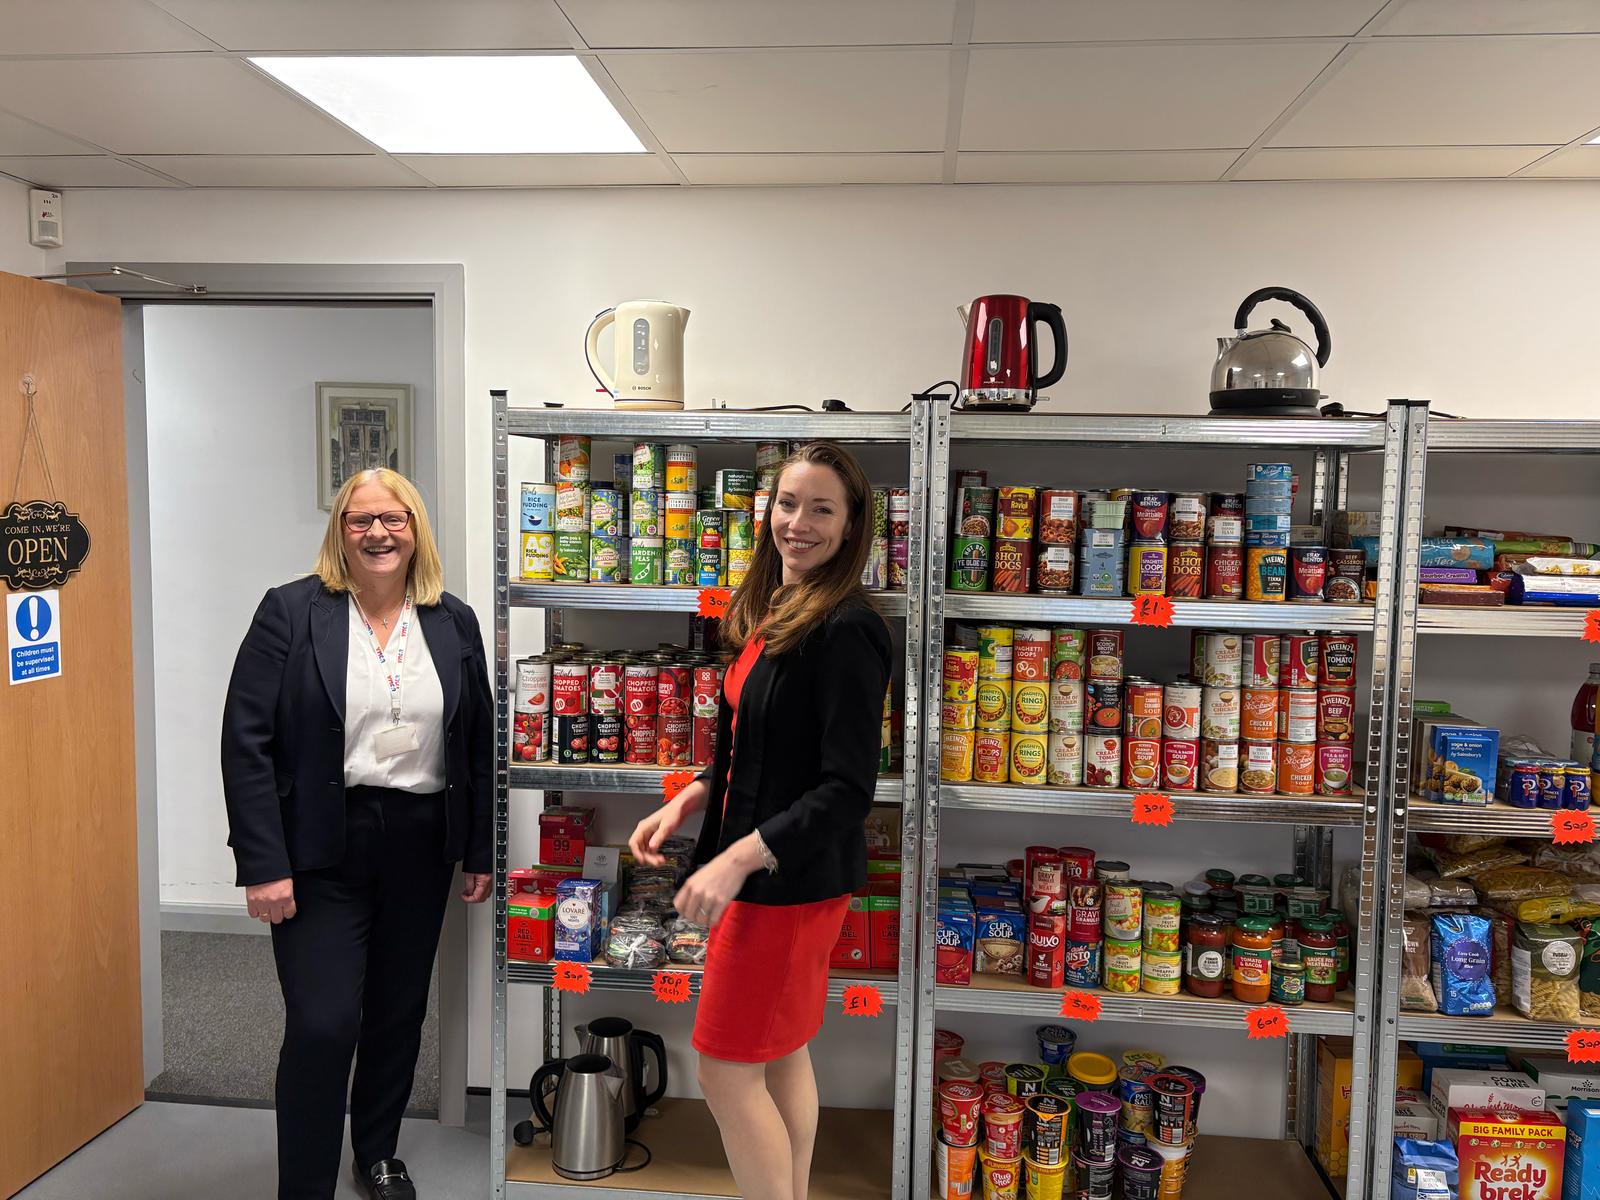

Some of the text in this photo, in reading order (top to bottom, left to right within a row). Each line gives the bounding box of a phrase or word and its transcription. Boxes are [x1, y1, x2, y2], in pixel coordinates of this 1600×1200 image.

[5, 526, 29, 535] COME
[45, 523, 71, 534] WE'RE
[8, 537, 69, 566] OPEN
[1173, 557, 1202, 566] 8 HOT
[1265, 555, 1286, 564] HEINZ
[995, 561, 1023, 570] DOGS
[1173, 566, 1201, 575] DOGS
[1329, 643, 1352, 652] HEINZ
[16, 646, 55, 659] Children must
[17, 655, 55, 668] be supervised
[1327, 655, 1353, 663] TOMATO
[22, 668, 29, 677] at
[36, 665, 51, 674] times
[1021, 691, 1043, 699] SPAGHETTI
[1021, 697, 1043, 705] RINGS
[1326, 697, 1347, 706] HEINZ
[1328, 707, 1343, 715] BEEF
[945, 735, 966, 744] HEINZ
[979, 738, 1001, 747] HEINZ
[978, 748, 1000, 756] HOOPS
[1019, 749, 1041, 757] RINGS
[553, 839, 571, 852] 99
[562, 907, 586, 915] LOVARÉ
[989, 922, 1007, 930] CUP
[937, 930, 954, 938] CUP
[989, 929, 1014, 940] SOUP
[936, 937, 961, 948] SOUP
[1066, 951, 1090, 962] BISTO
[1240, 956, 1262, 964] TOMATO
[1451, 955, 1468, 964] Long
[660, 975, 683, 987] 50p
[1449, 990, 1457, 998] 15
[848, 996, 868, 1009] £1
[1490, 1075, 1528, 1084] CORN
[1024, 1083, 1036, 1092] N
[1473, 1125, 1554, 1138] BIG FAMILY PACK
[1473, 1161, 1548, 1189] Ready
[1479, 1181, 1538, 1200] brek
